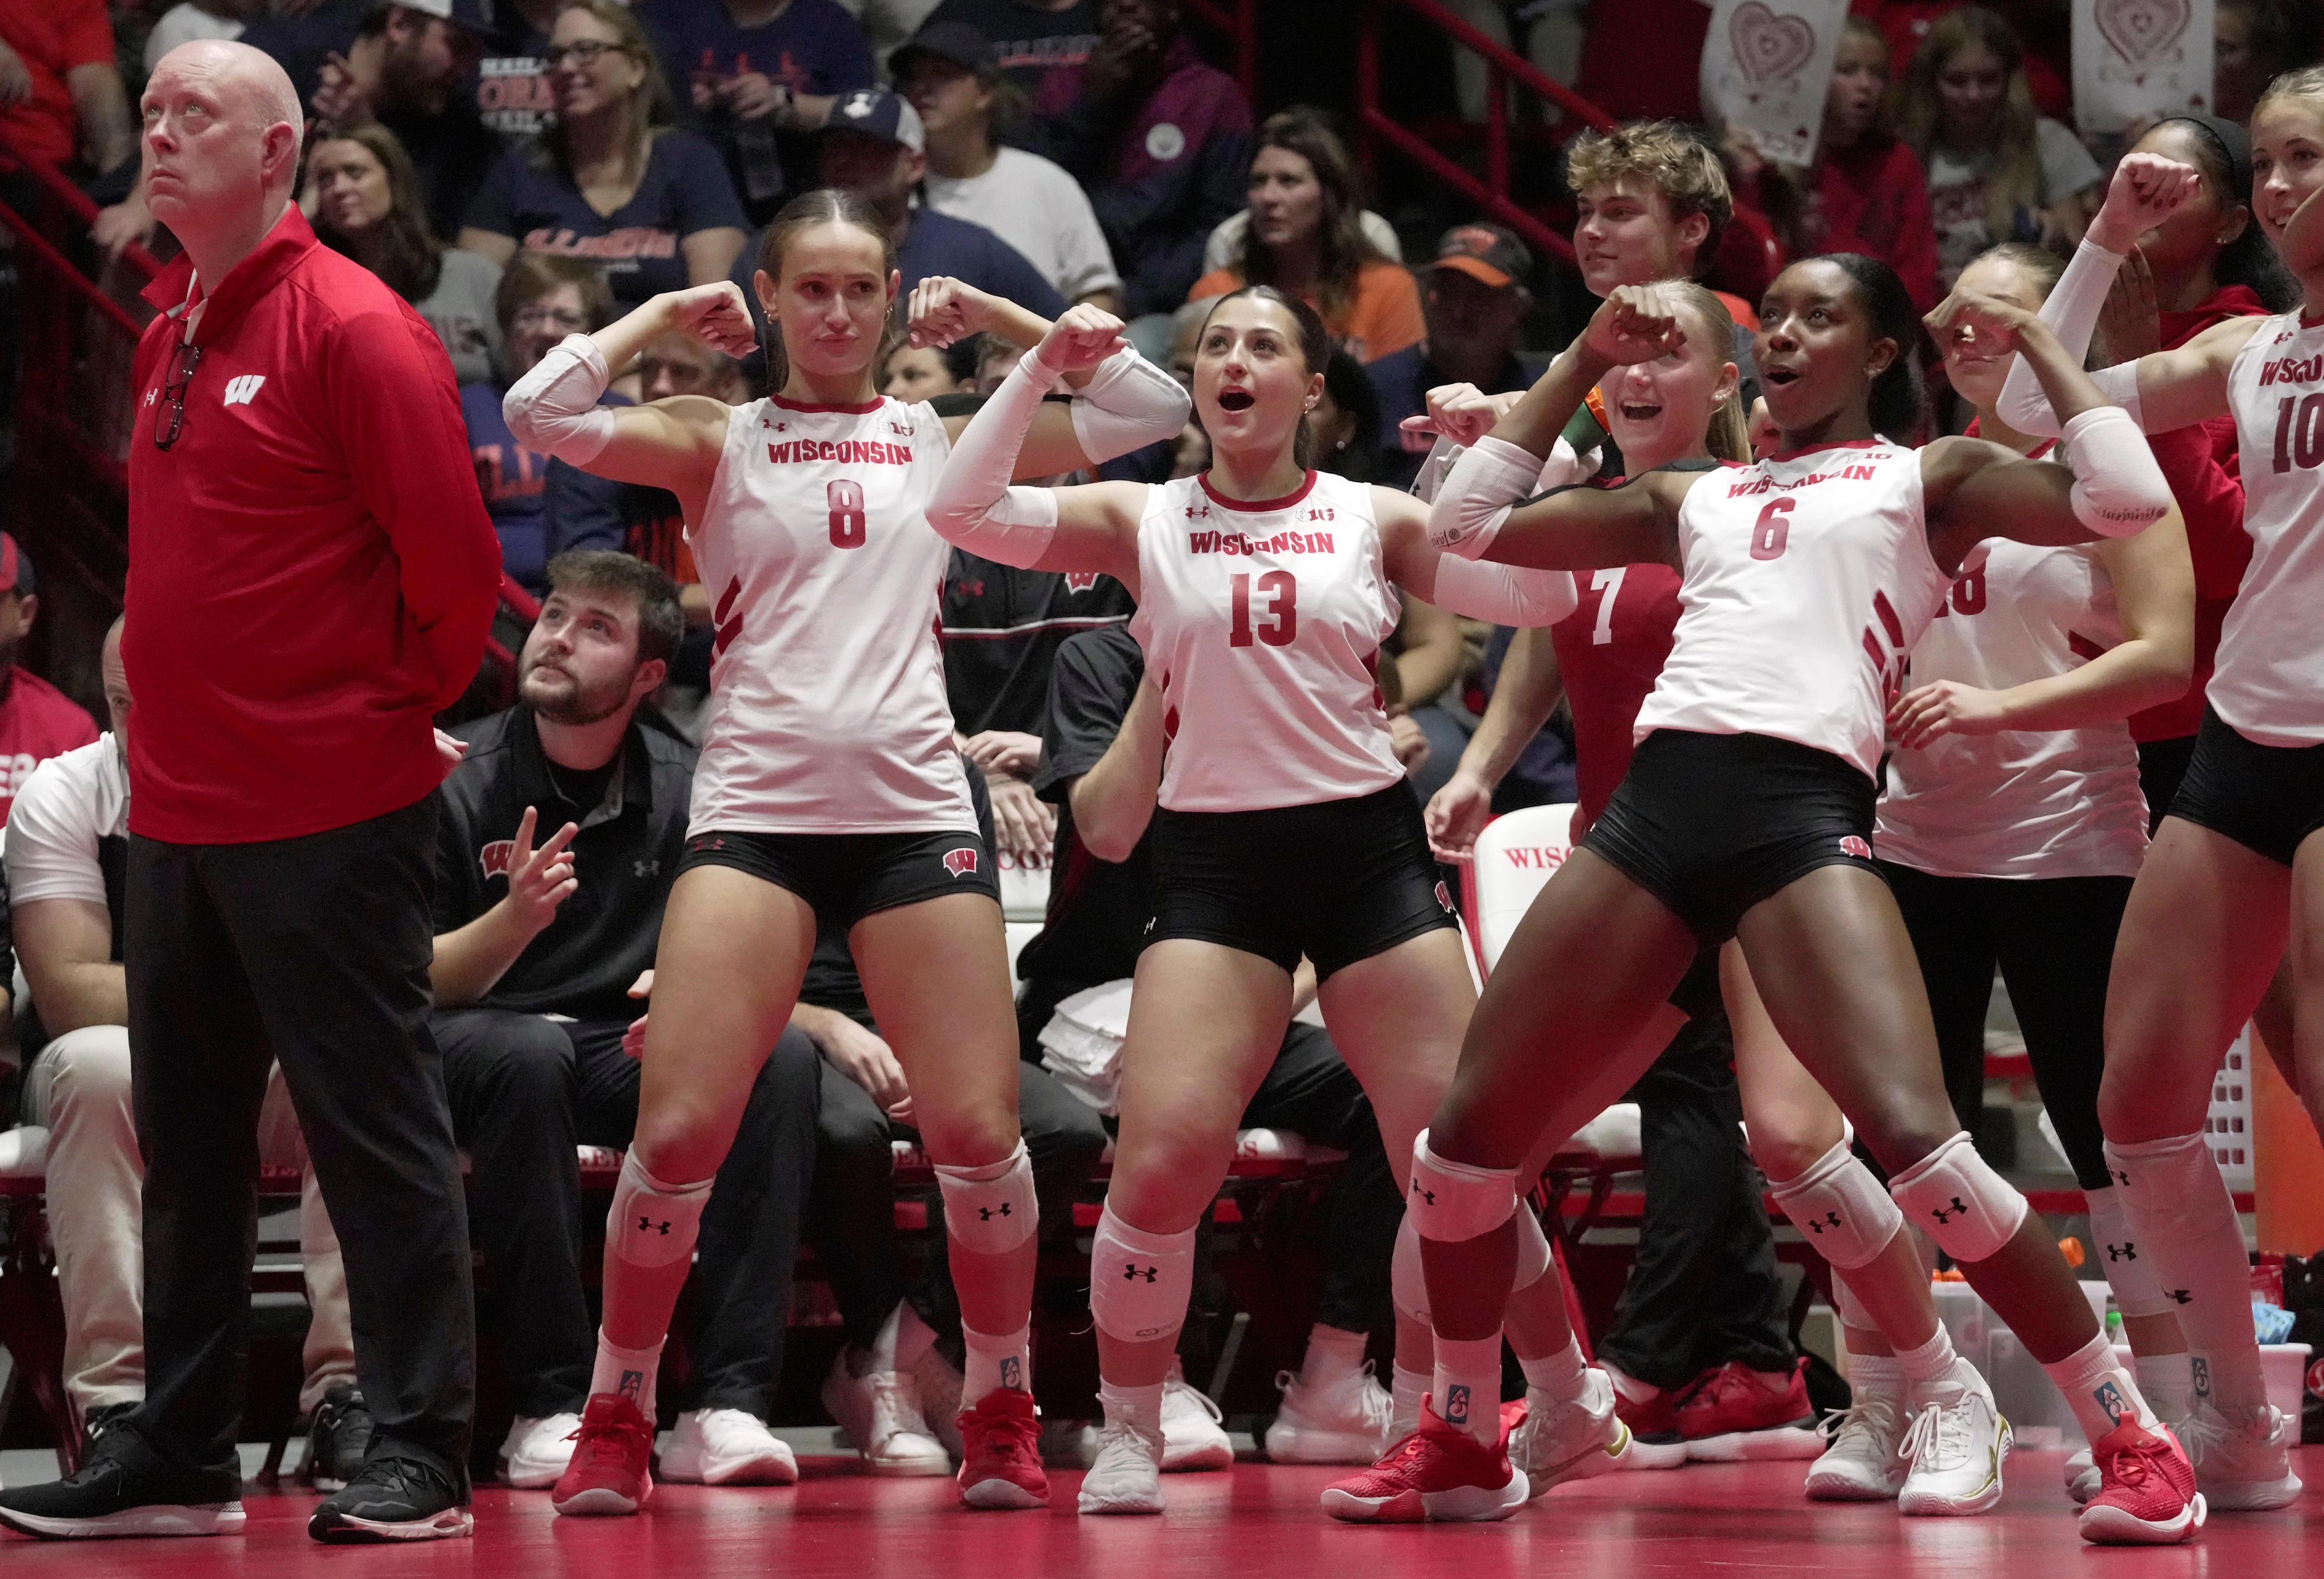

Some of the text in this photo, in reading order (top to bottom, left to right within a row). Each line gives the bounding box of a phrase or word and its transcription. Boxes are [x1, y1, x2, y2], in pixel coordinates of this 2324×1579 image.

[224, 375, 265, 406] W
[767, 438, 912, 465] WISCONSIN
[1727, 465, 1877, 499] WISONIN
[827, 479, 866, 549] 8
[1750, 496, 1797, 561] 6
[1189, 530, 1335, 556] WISCONSIN
[1229, 570, 1296, 647] 13
[1590, 567, 1627, 645] 7
